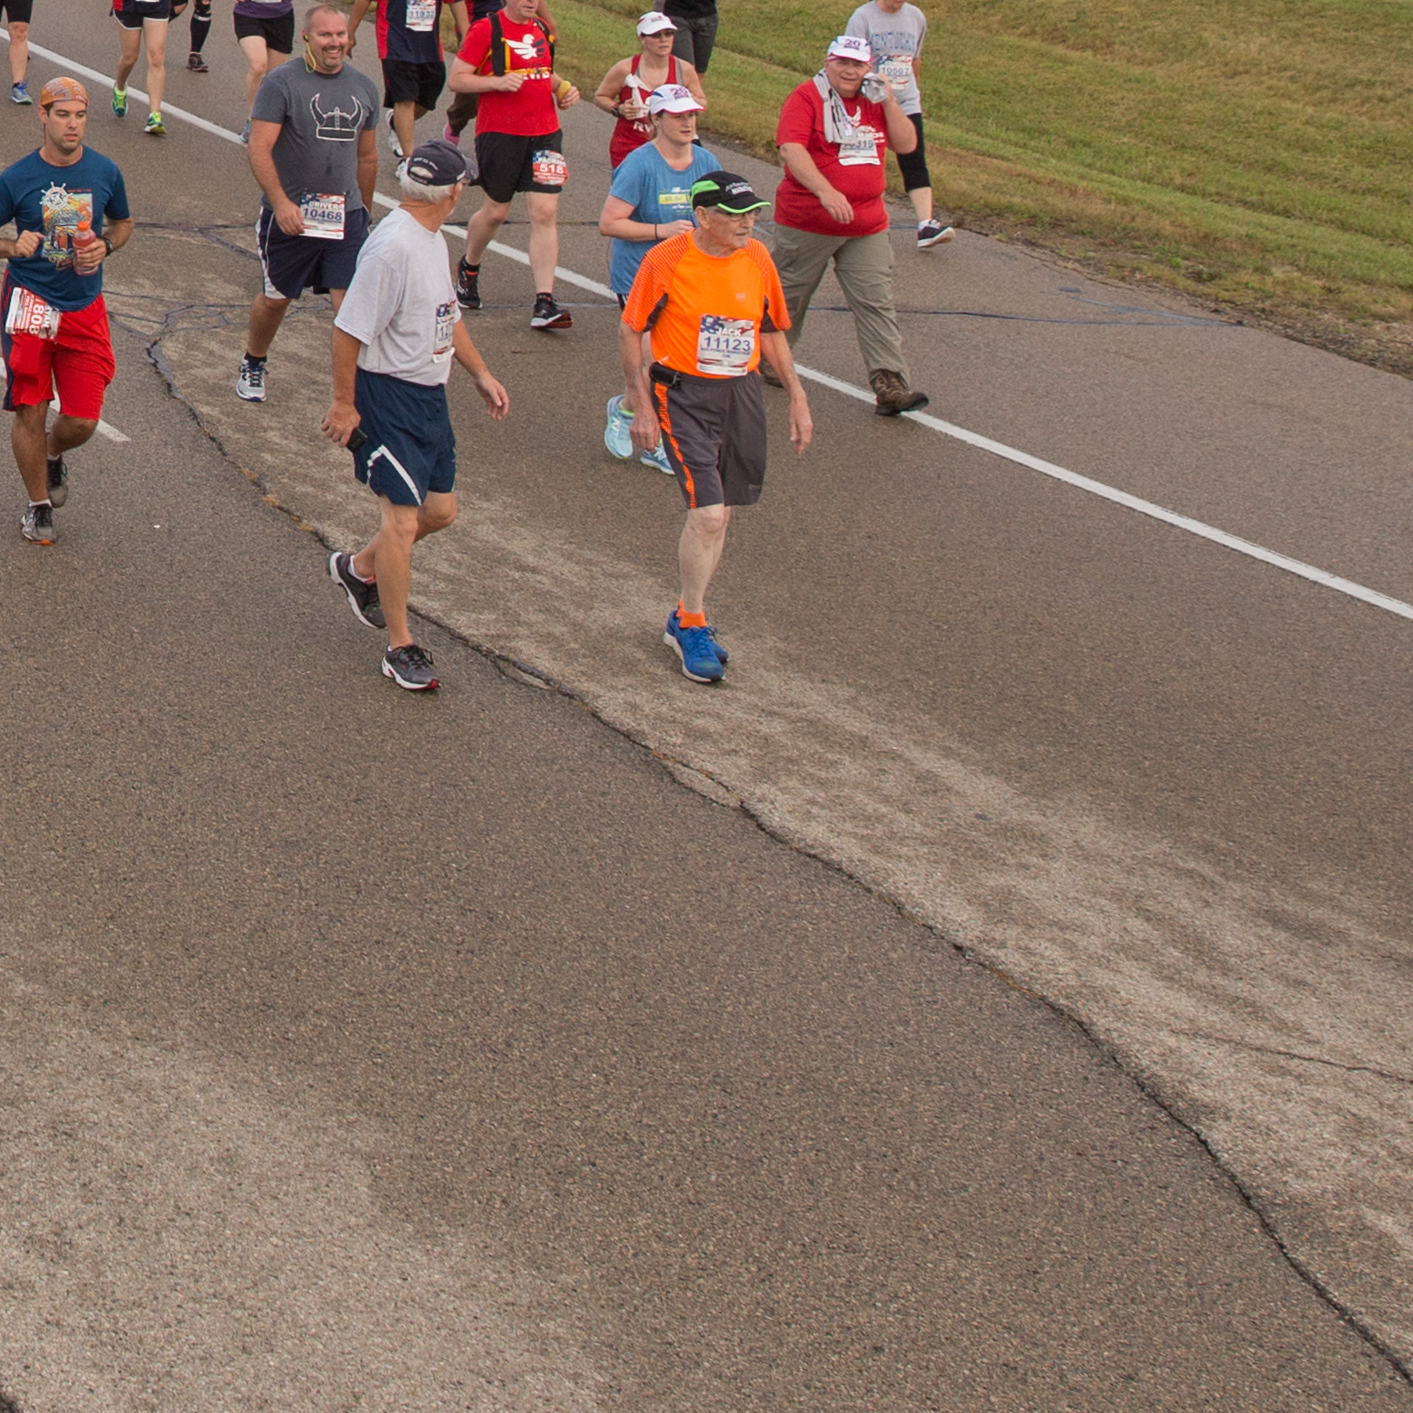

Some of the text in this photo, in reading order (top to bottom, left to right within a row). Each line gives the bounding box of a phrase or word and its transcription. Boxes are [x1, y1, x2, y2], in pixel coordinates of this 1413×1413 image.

[539, 163, 564, 174] 518
[303, 207, 342, 221] 10468
[716, 326, 742, 337] JACK
[704, 336, 751, 352] 11123
